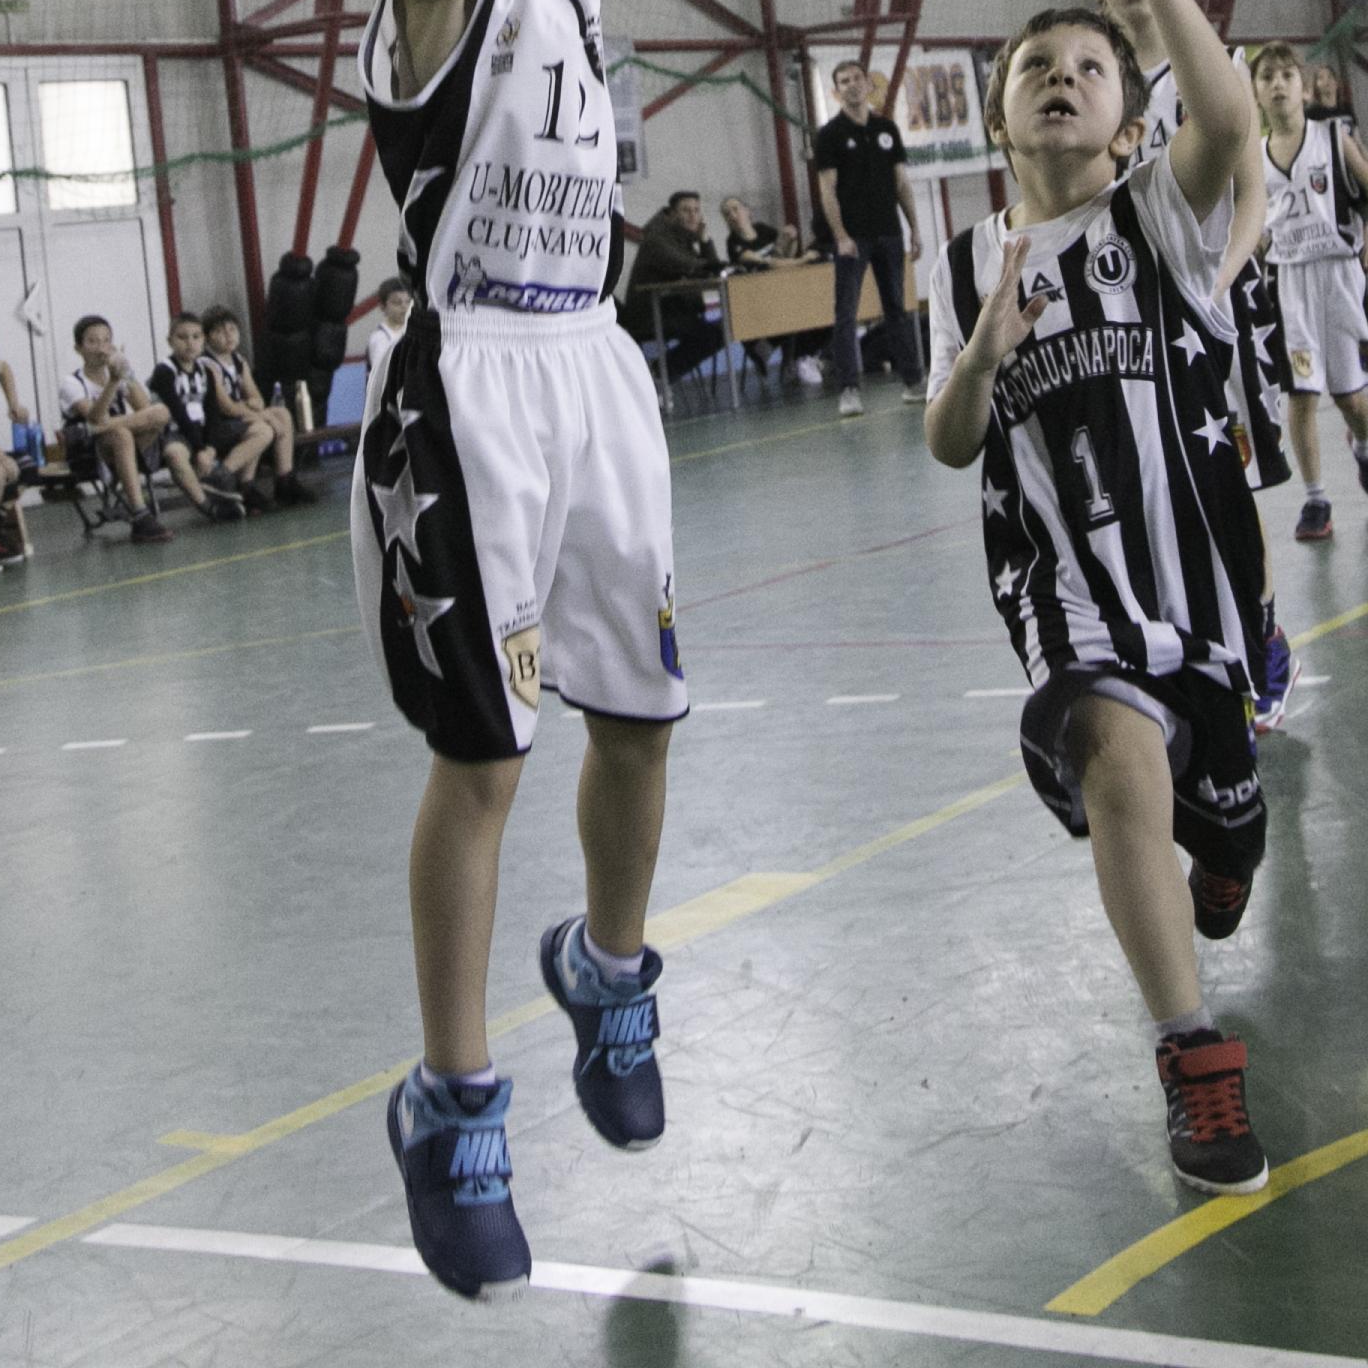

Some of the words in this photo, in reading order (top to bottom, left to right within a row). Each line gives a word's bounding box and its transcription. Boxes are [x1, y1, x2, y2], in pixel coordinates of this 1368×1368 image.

[1280, 186, 1312, 220] 21
[1021, 327, 1155, 399] CLUJ-NAPOCA
[1070, 424, 1116, 523] 1
[596, 999, 654, 1044] NIKE
[449, 1129, 512, 1178] NIK
